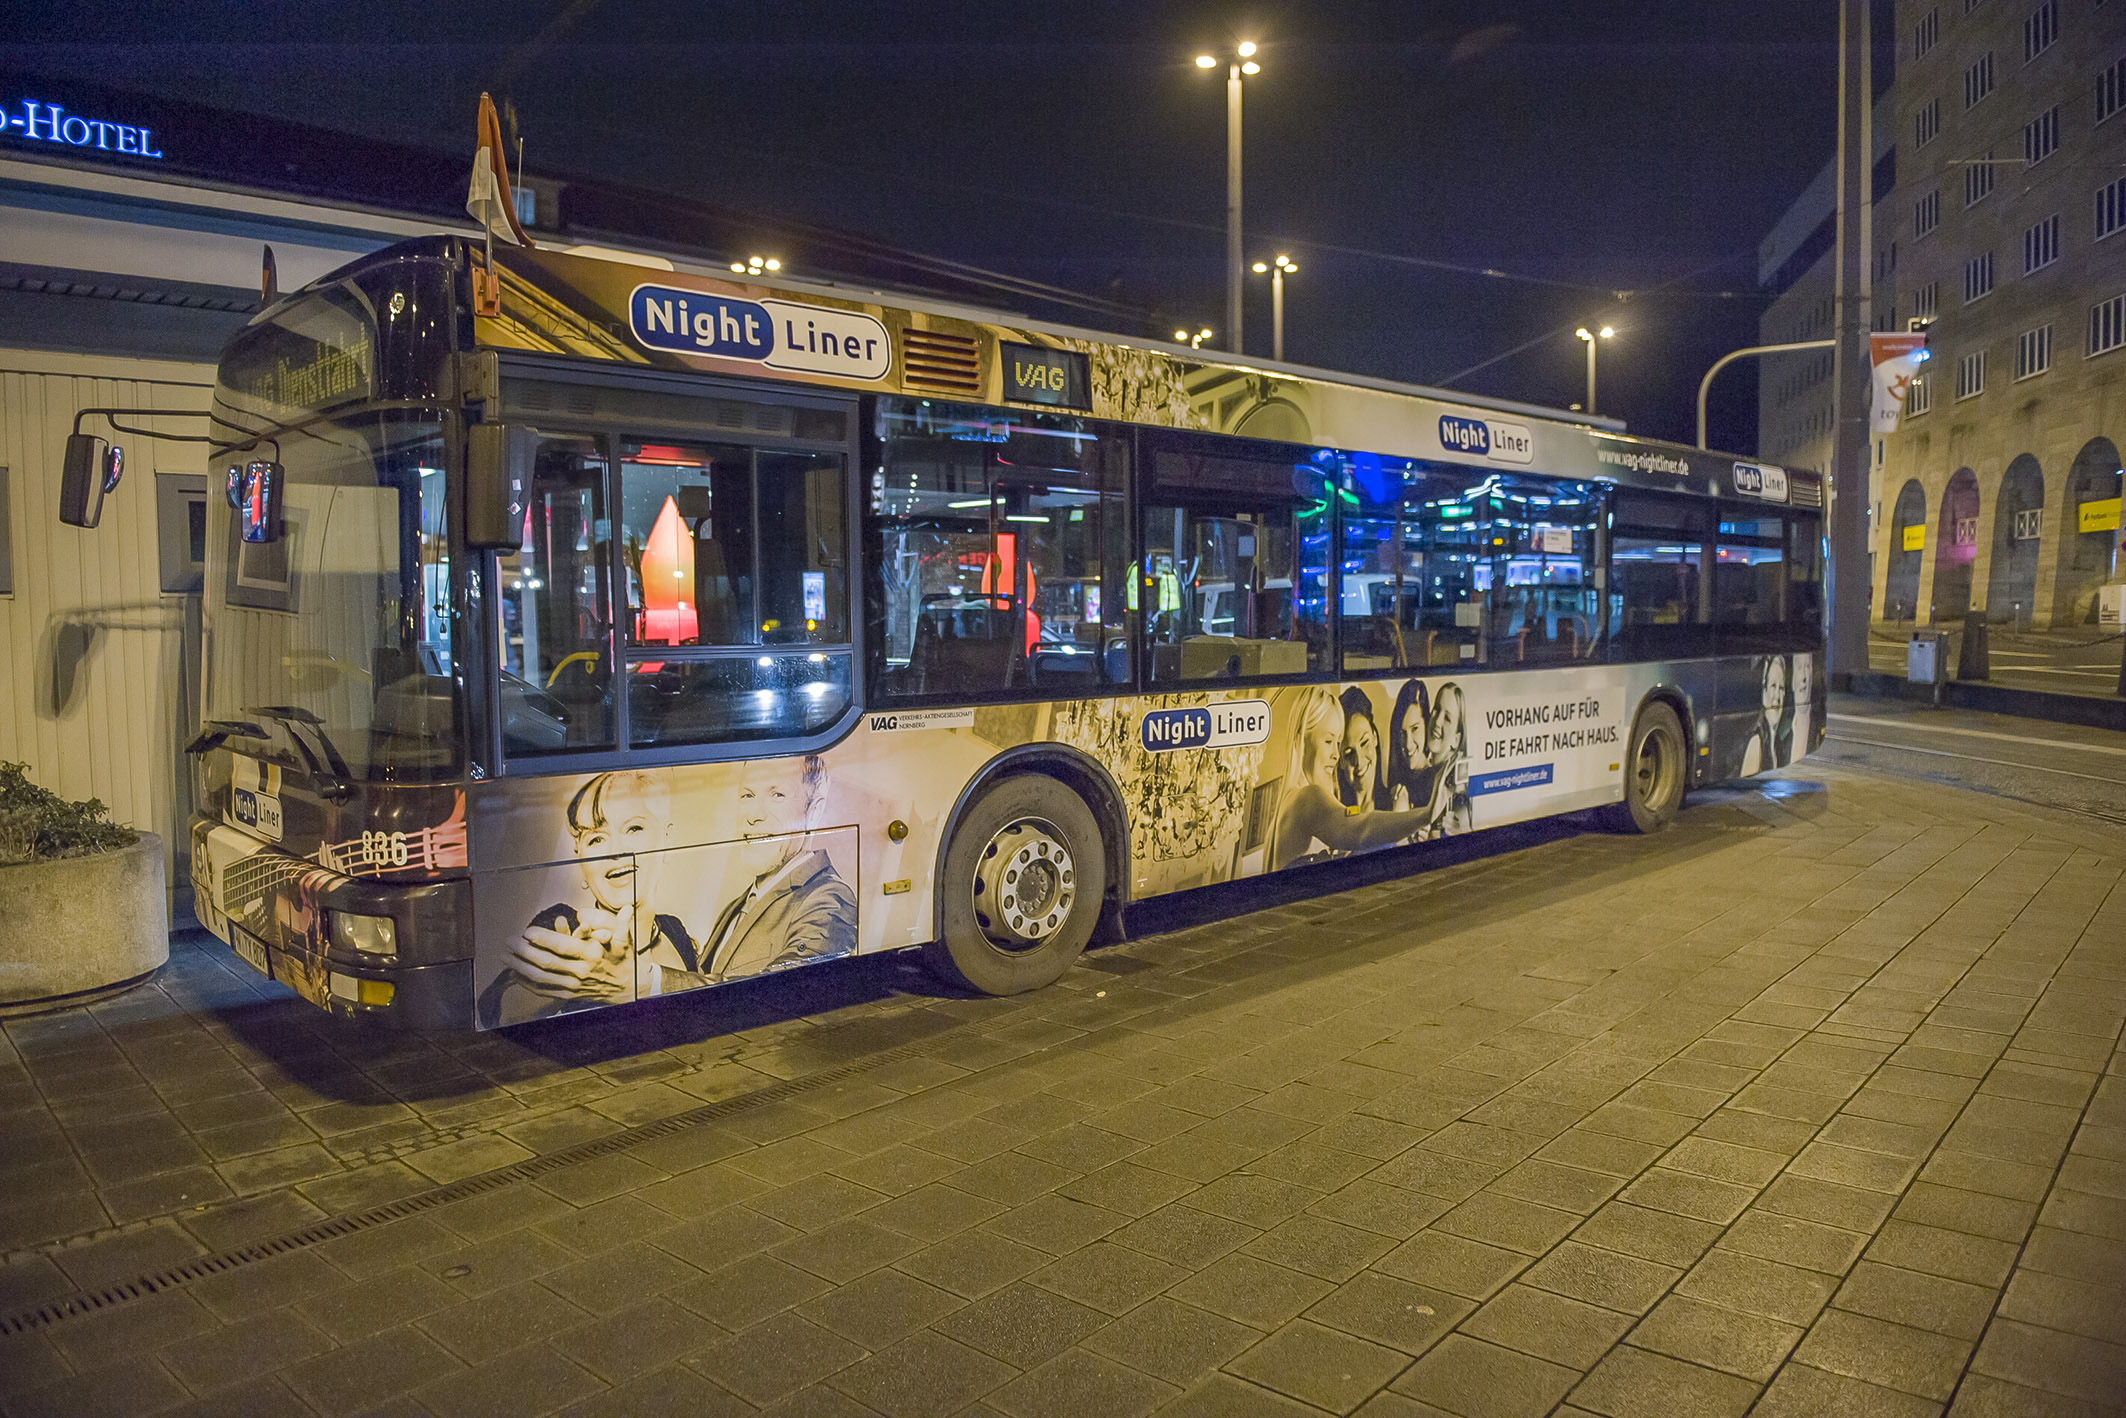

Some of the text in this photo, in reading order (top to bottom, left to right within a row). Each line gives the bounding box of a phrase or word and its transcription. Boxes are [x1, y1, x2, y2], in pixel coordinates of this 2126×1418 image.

[646, 297, 878, 361] Night Liner
[1015, 361, 1065, 392] VAG
[1442, 420, 1529, 452] Night Liner
[1598, 450, 1689, 476] www.vag-nightliner.de
[1736, 467, 1784, 491] Night Liner
[870, 716, 898, 731] VAG
[1148, 712, 1265, 745] Night Liner
[1486, 696, 1600, 729] VORHANG AUF FÜR
[1485, 725, 1619, 760] DIE FAHRT NACH HAUS.
[1484, 770, 1547, 789] www.vag-nightliner.de
[235, 794, 280, 828] Night Liner
[362, 830, 408, 866] 836
